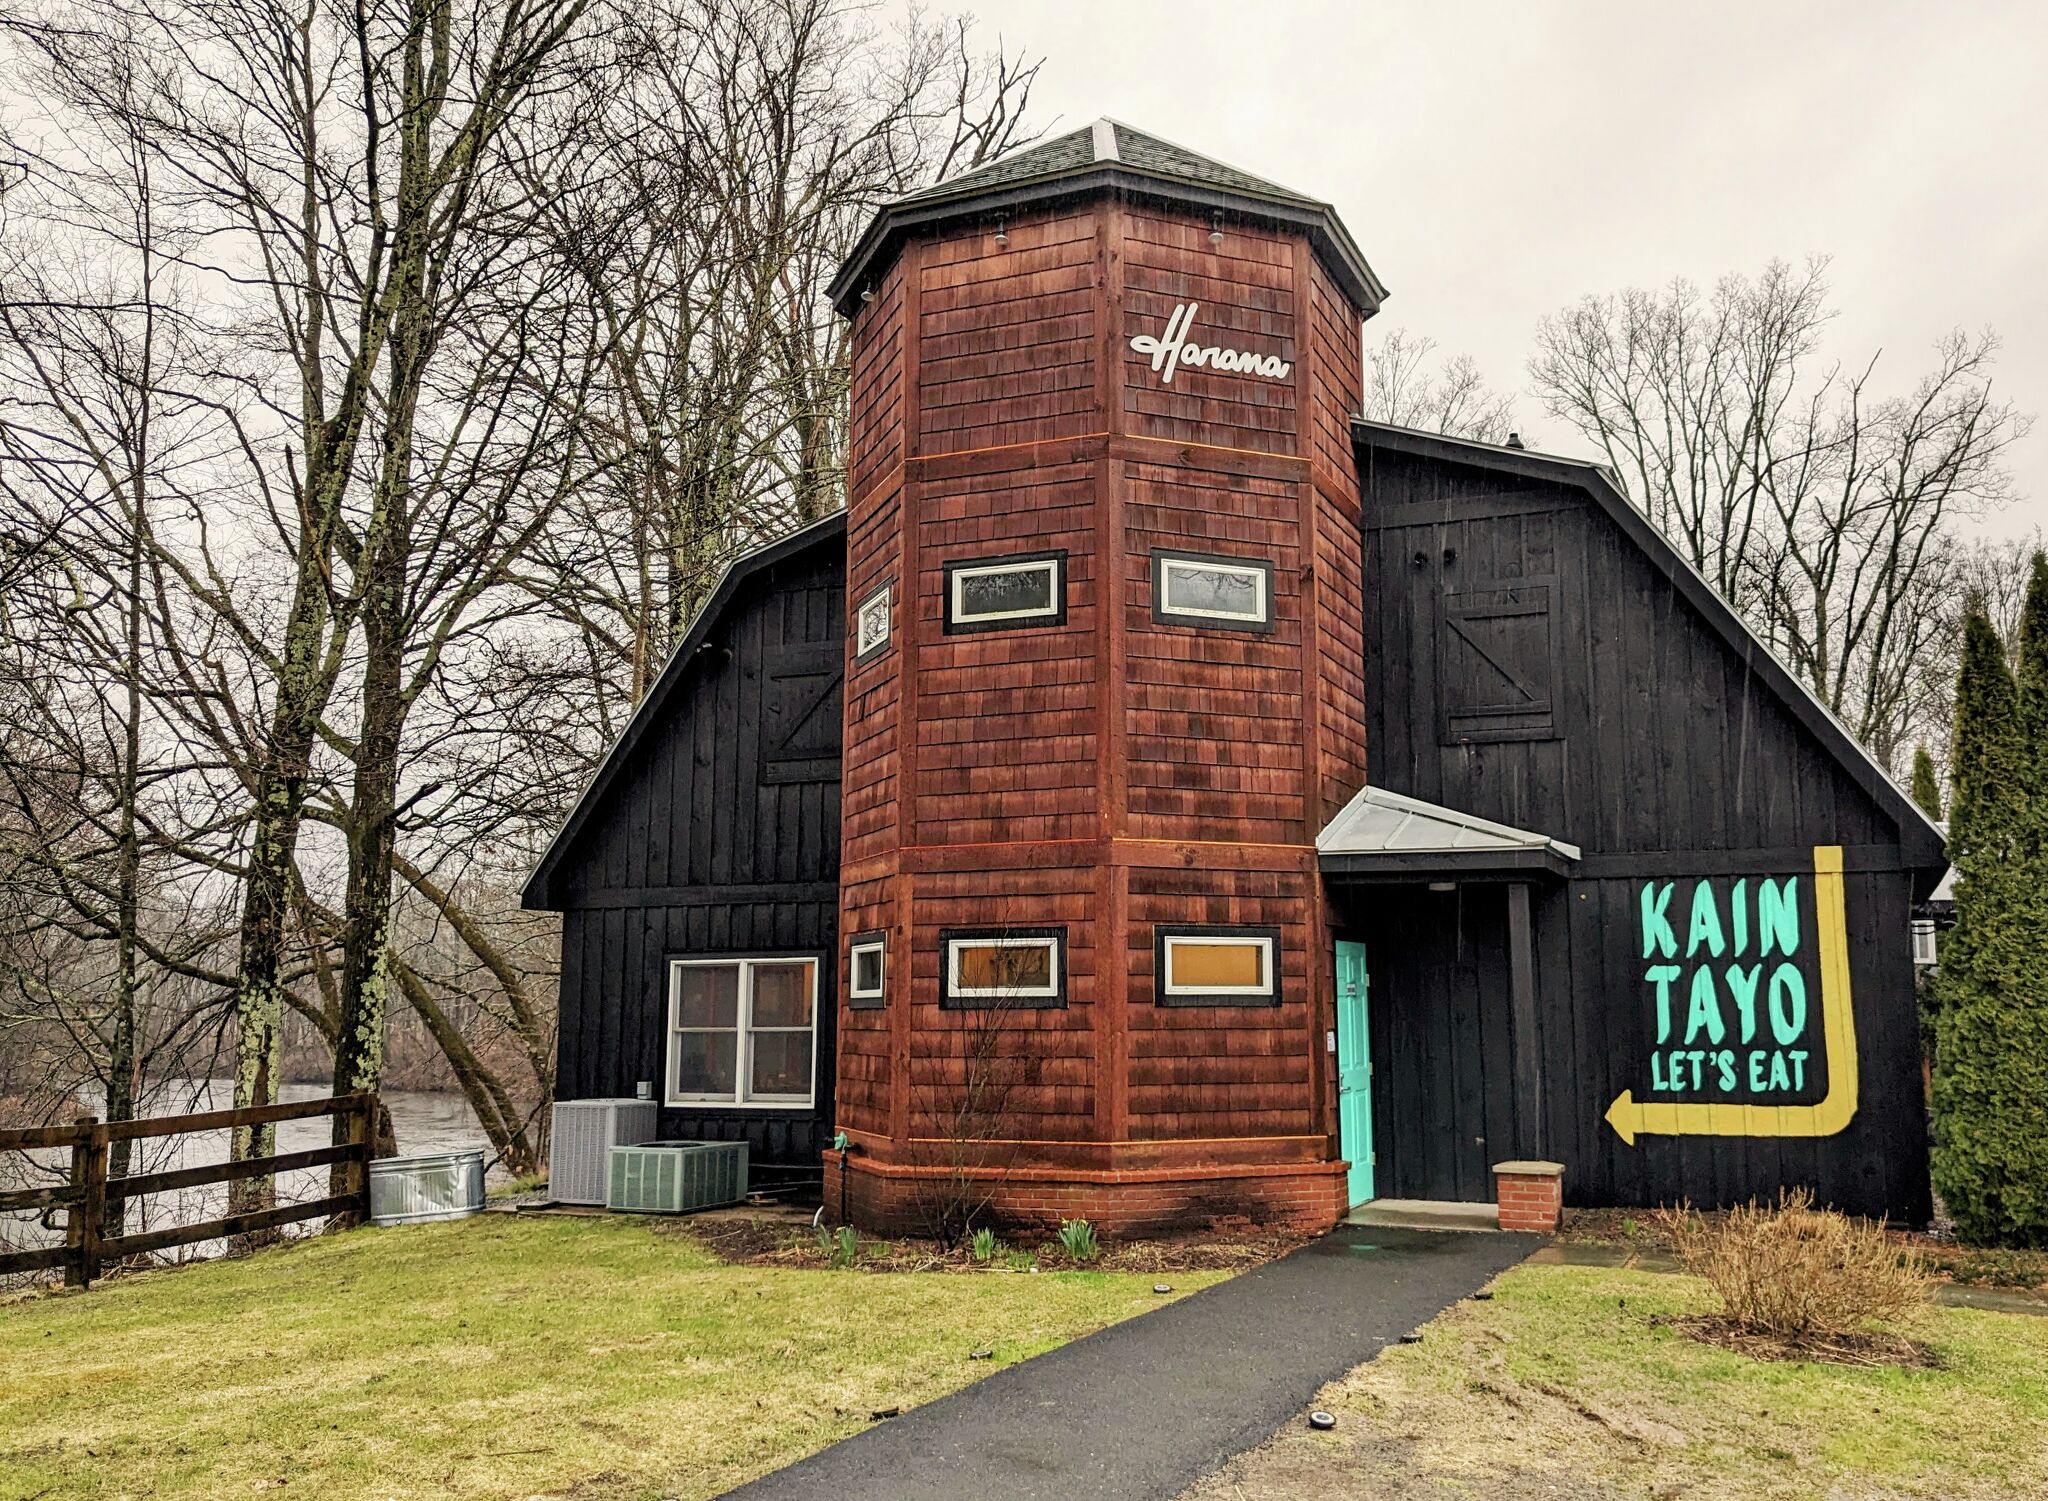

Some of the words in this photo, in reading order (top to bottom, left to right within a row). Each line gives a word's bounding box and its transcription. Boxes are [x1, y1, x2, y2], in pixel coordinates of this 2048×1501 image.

[1130, 302, 1290, 383] Harana
[1640, 876, 1799, 959] KAIN
[1644, 962, 1807, 1046] TAYO
[1651, 1049, 1737, 1092] LET'S
[1748, 1049, 1809, 1092] EAT
